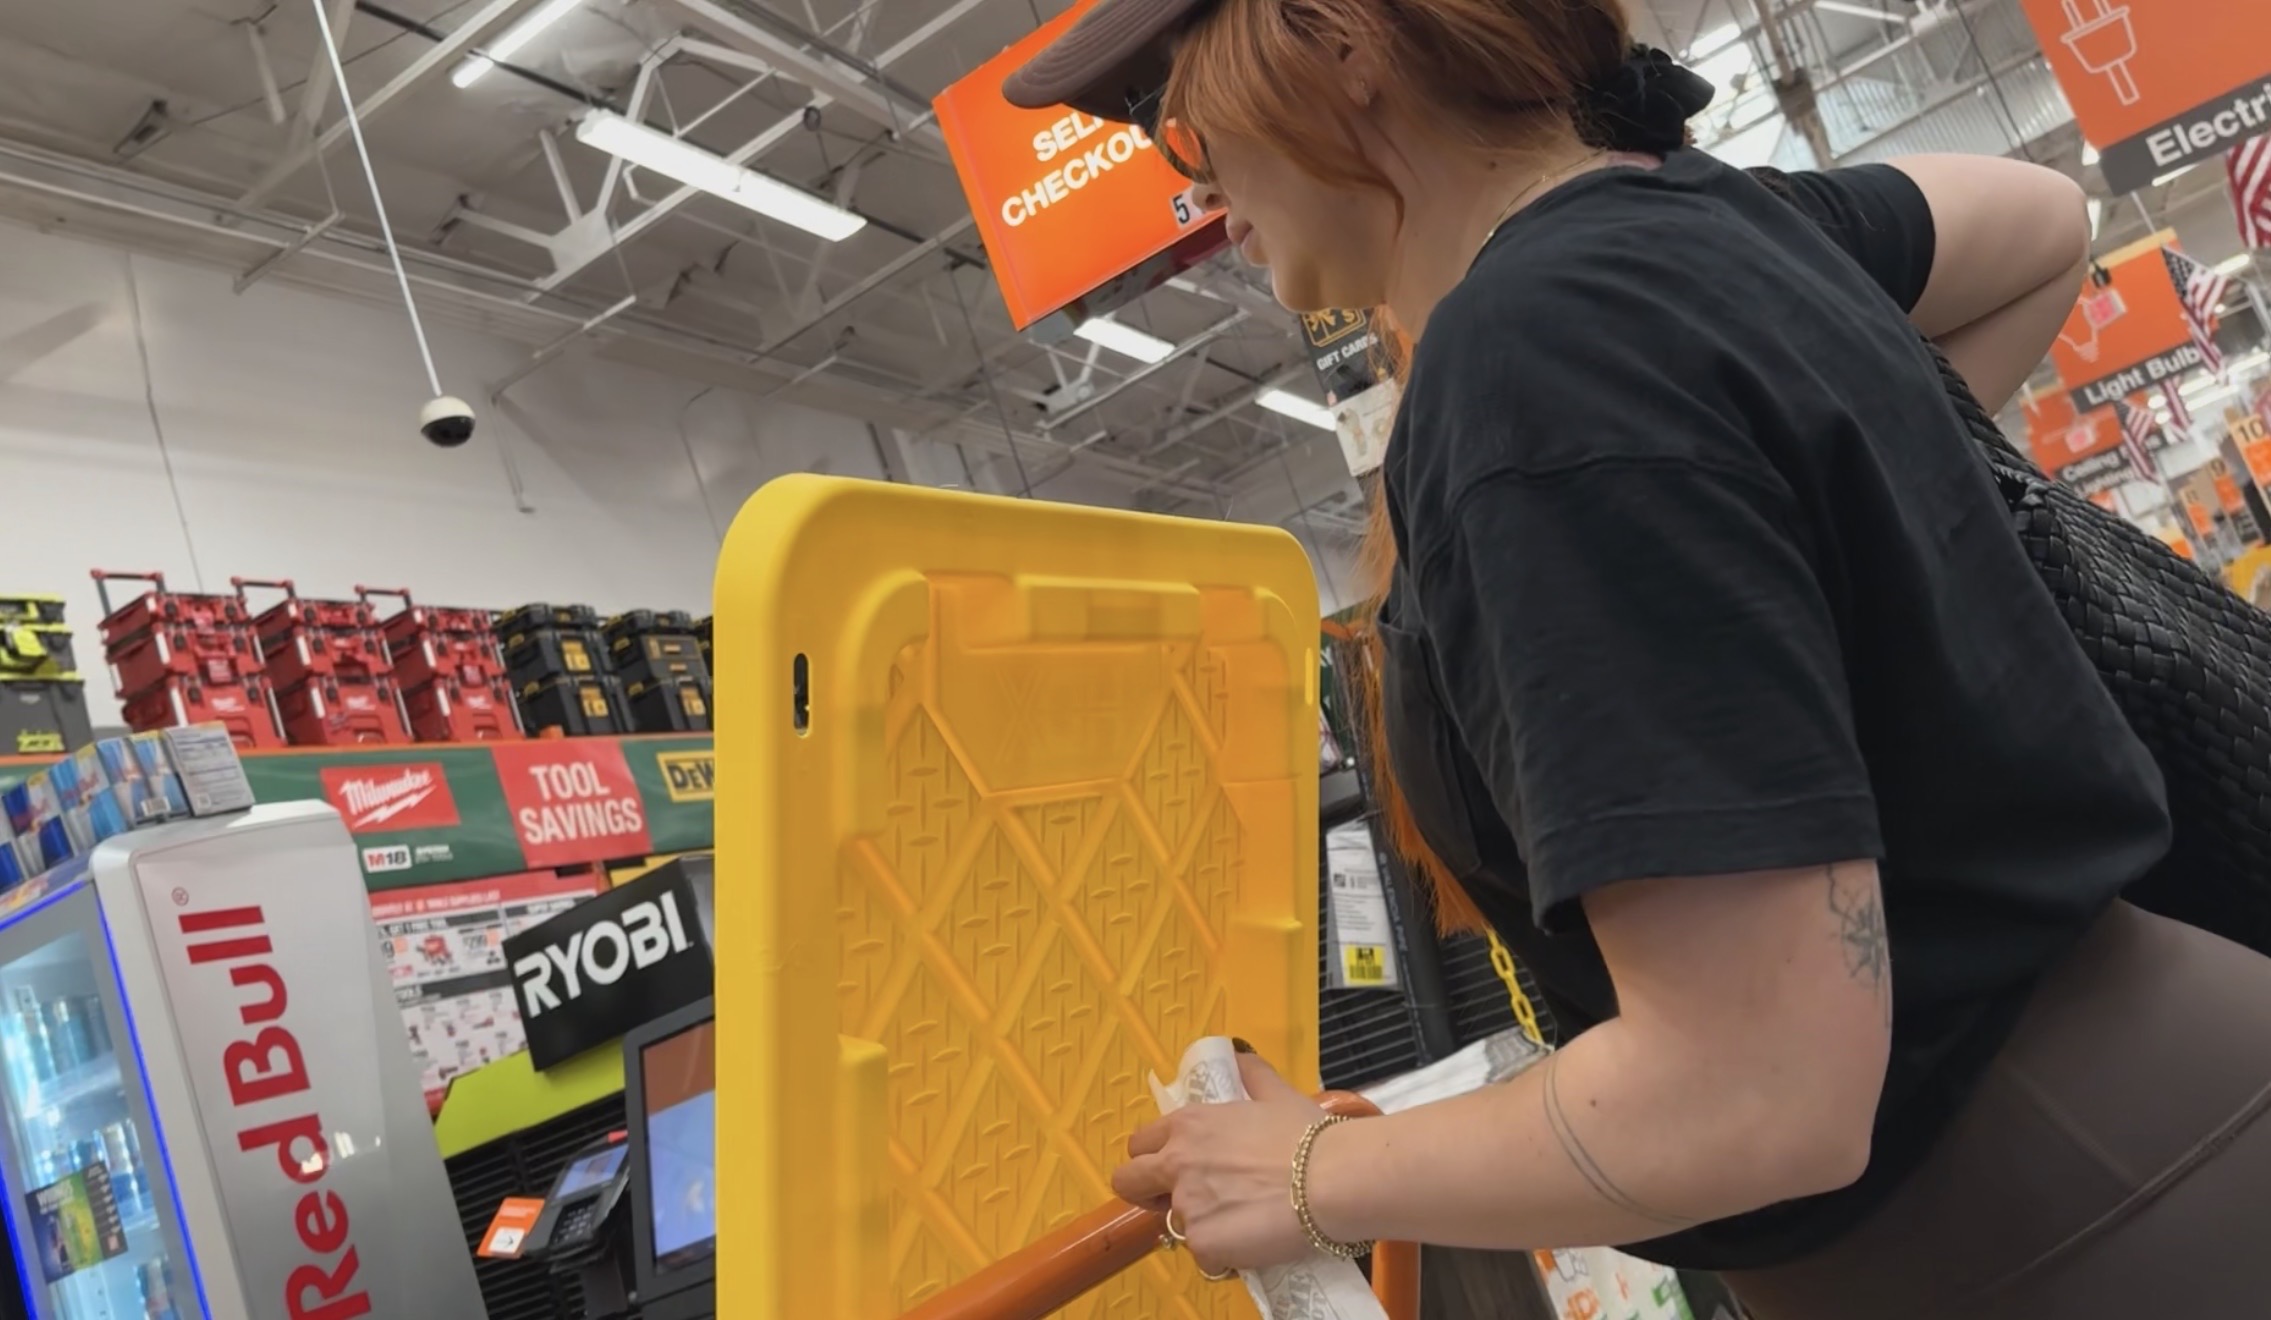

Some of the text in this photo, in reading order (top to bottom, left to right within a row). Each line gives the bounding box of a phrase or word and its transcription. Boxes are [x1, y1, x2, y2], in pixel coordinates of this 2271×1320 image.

[1001, 124, 1153, 227] CHECKOU
[1173, 193, 1190, 224] 5
[1316, 350, 1340, 371] GIFT
[2084, 346, 2201, 405] Light Bulb
[2239, 418, 2265, 443] 10
[338, 767, 434, 816] Milwaukee
[529, 761, 610, 801] TOOL
[667, 762, 714, 790] DEW
[520, 797, 643, 845] SAVINGS
[368, 850, 408, 869] M18
[513, 890, 688, 1019] RYOBI
[177, 905, 311, 1107] Bull
[237, 1114, 371, 1320] Red
